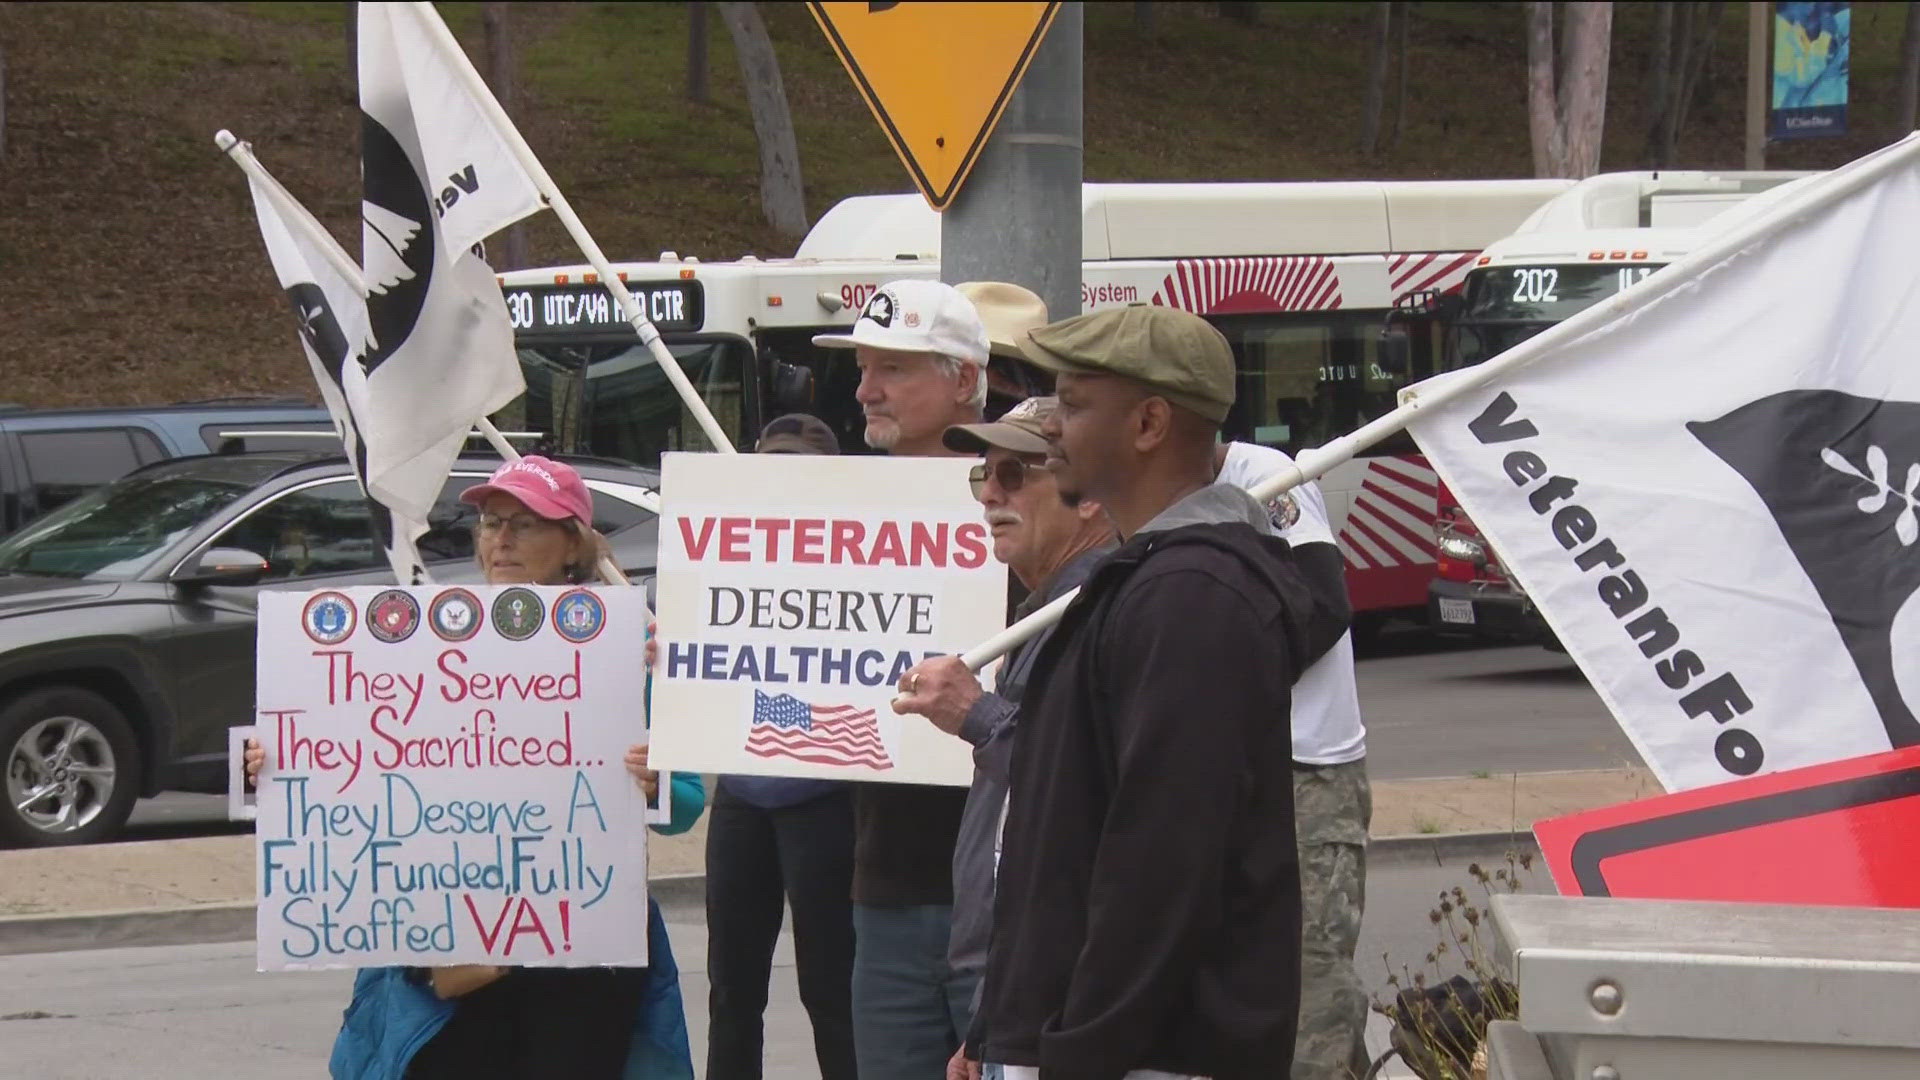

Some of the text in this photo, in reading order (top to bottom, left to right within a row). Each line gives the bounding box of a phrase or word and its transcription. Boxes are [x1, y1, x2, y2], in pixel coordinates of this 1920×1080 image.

[544, 293, 609, 325] UTC/VA
[651, 289, 684, 322] CTR
[1512, 268, 1558, 303] 202
[677, 516, 988, 569] VETERANS
[708, 586, 934, 635] DESERVE
[312, 649, 582, 725] They Served
[667, 642, 980, 687] HEALTHCA
[260, 705, 604, 793] They Sacrificed...
[272, 770, 607, 863] They Deserve A
[263, 836, 614, 913] Fully Funded, Fully
[282, 893, 573, 958] Staffed VA!
